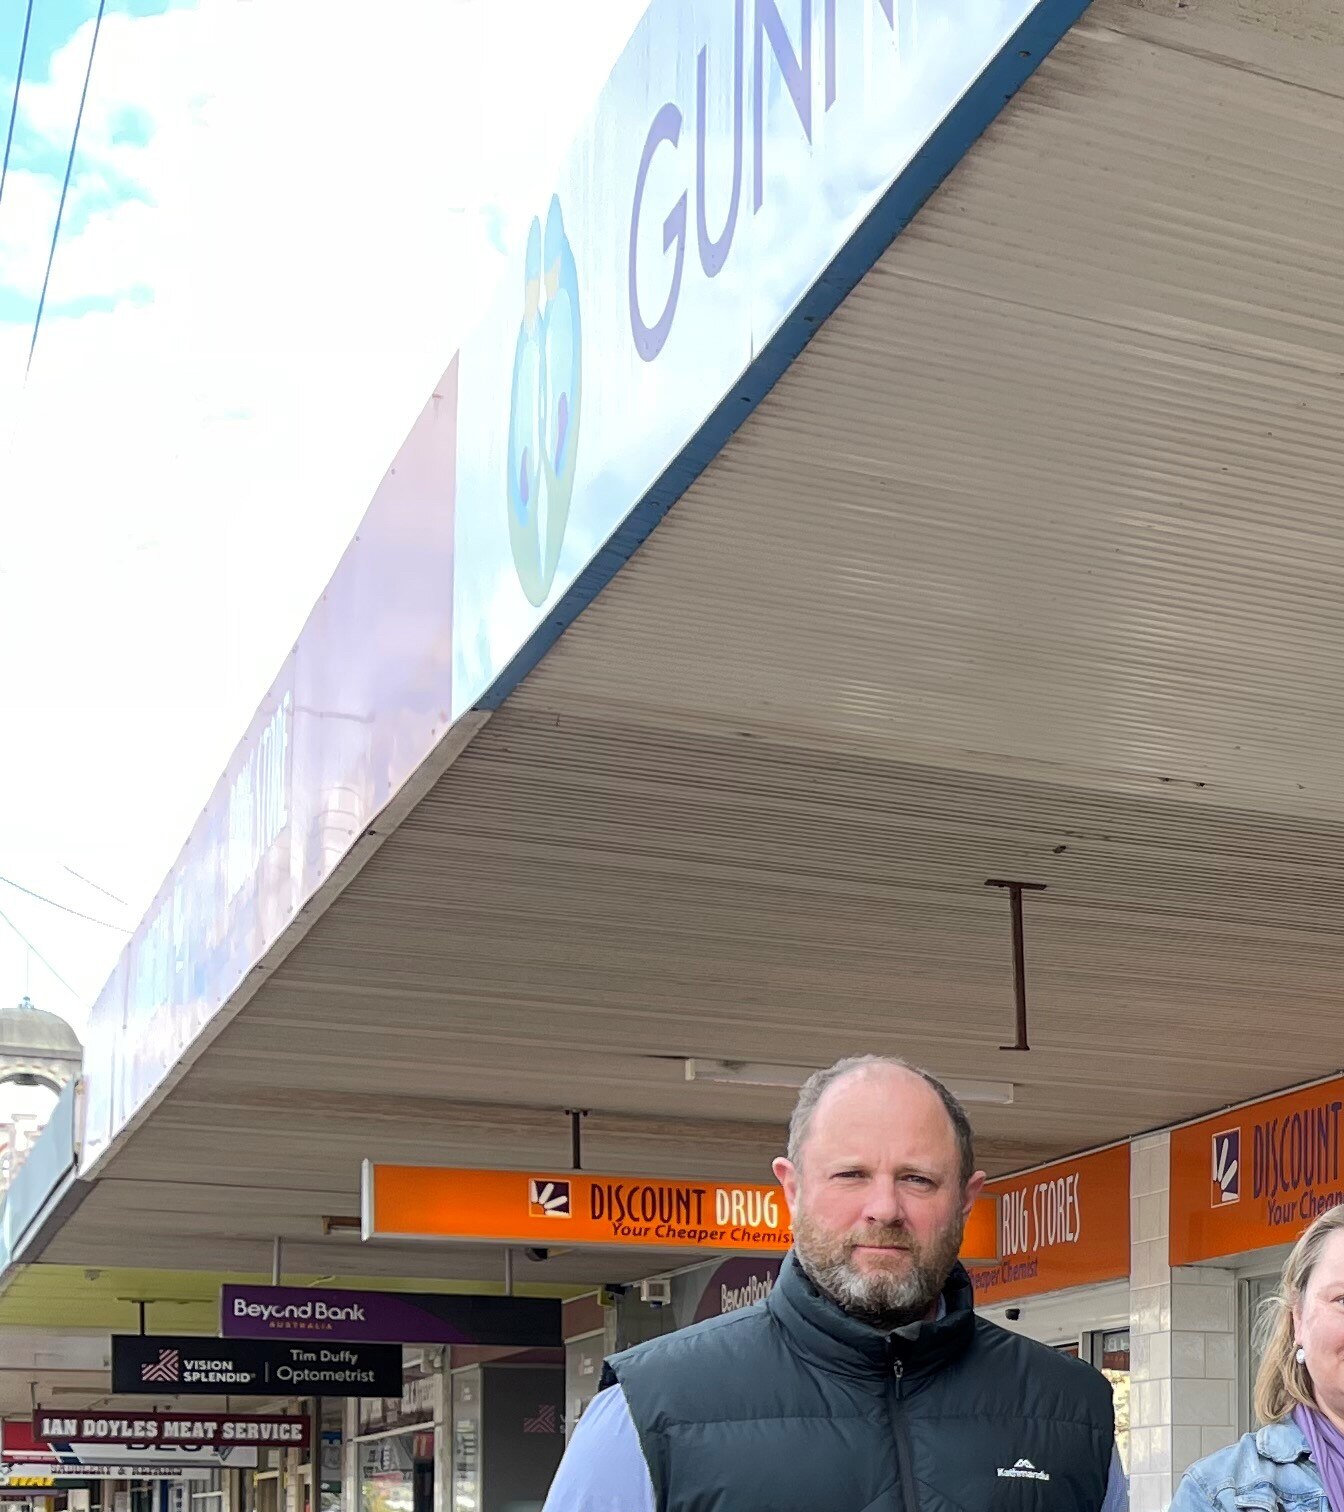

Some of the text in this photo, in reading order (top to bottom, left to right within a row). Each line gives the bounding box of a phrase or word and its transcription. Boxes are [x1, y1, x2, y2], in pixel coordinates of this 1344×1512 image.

[1253, 1101, 1342, 1200] DISCOUNT
[590, 1183, 778, 1228] DISCOUNT DRUG
[1002, 1172, 1080, 1256] RUG STORES
[1267, 1198, 1297, 1226] Your
[612, 1222, 652, 1237] Your
[655, 1225, 724, 1243] Cheaper
[233, 1298, 365, 1321] Beyond Bank
[183, 1360, 233, 1371] VISION
[290, 1349, 358, 1365] Tim Duffy
[183, 1372, 251, 1383] SPLENDID
[277, 1365, 375, 1383] Optometrist
[42, 1418, 303, 1441] IAN DOYLES MEAT SERVICE
